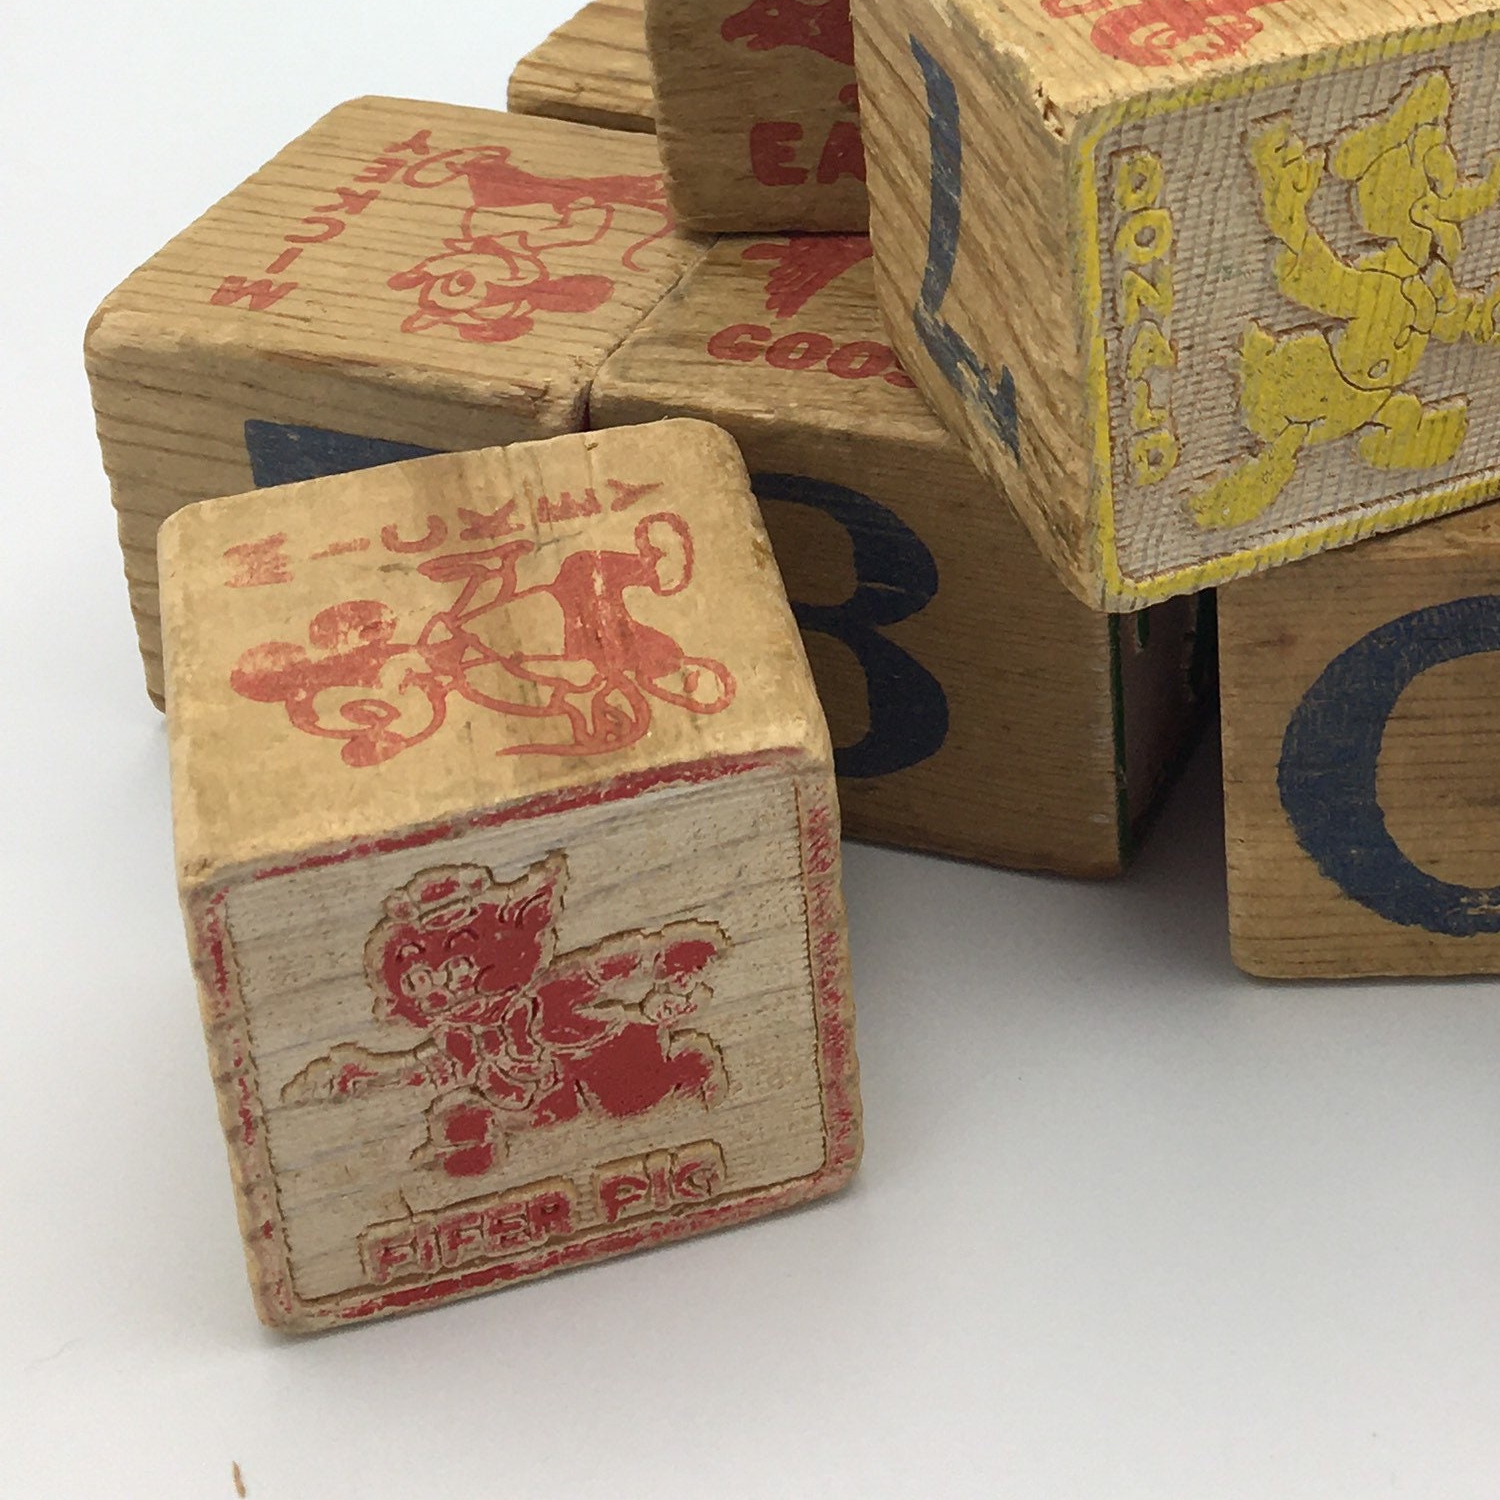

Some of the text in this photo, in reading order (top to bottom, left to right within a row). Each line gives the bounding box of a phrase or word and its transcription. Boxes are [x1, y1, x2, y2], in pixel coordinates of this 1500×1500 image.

[749, 120, 867, 187] EA
[209, 129, 433, 311] MICKEY
[1114, 150, 1181, 487] DONALD
[223, 479, 664, 588] MICKEY
[598, 1160, 724, 1224] PIG
